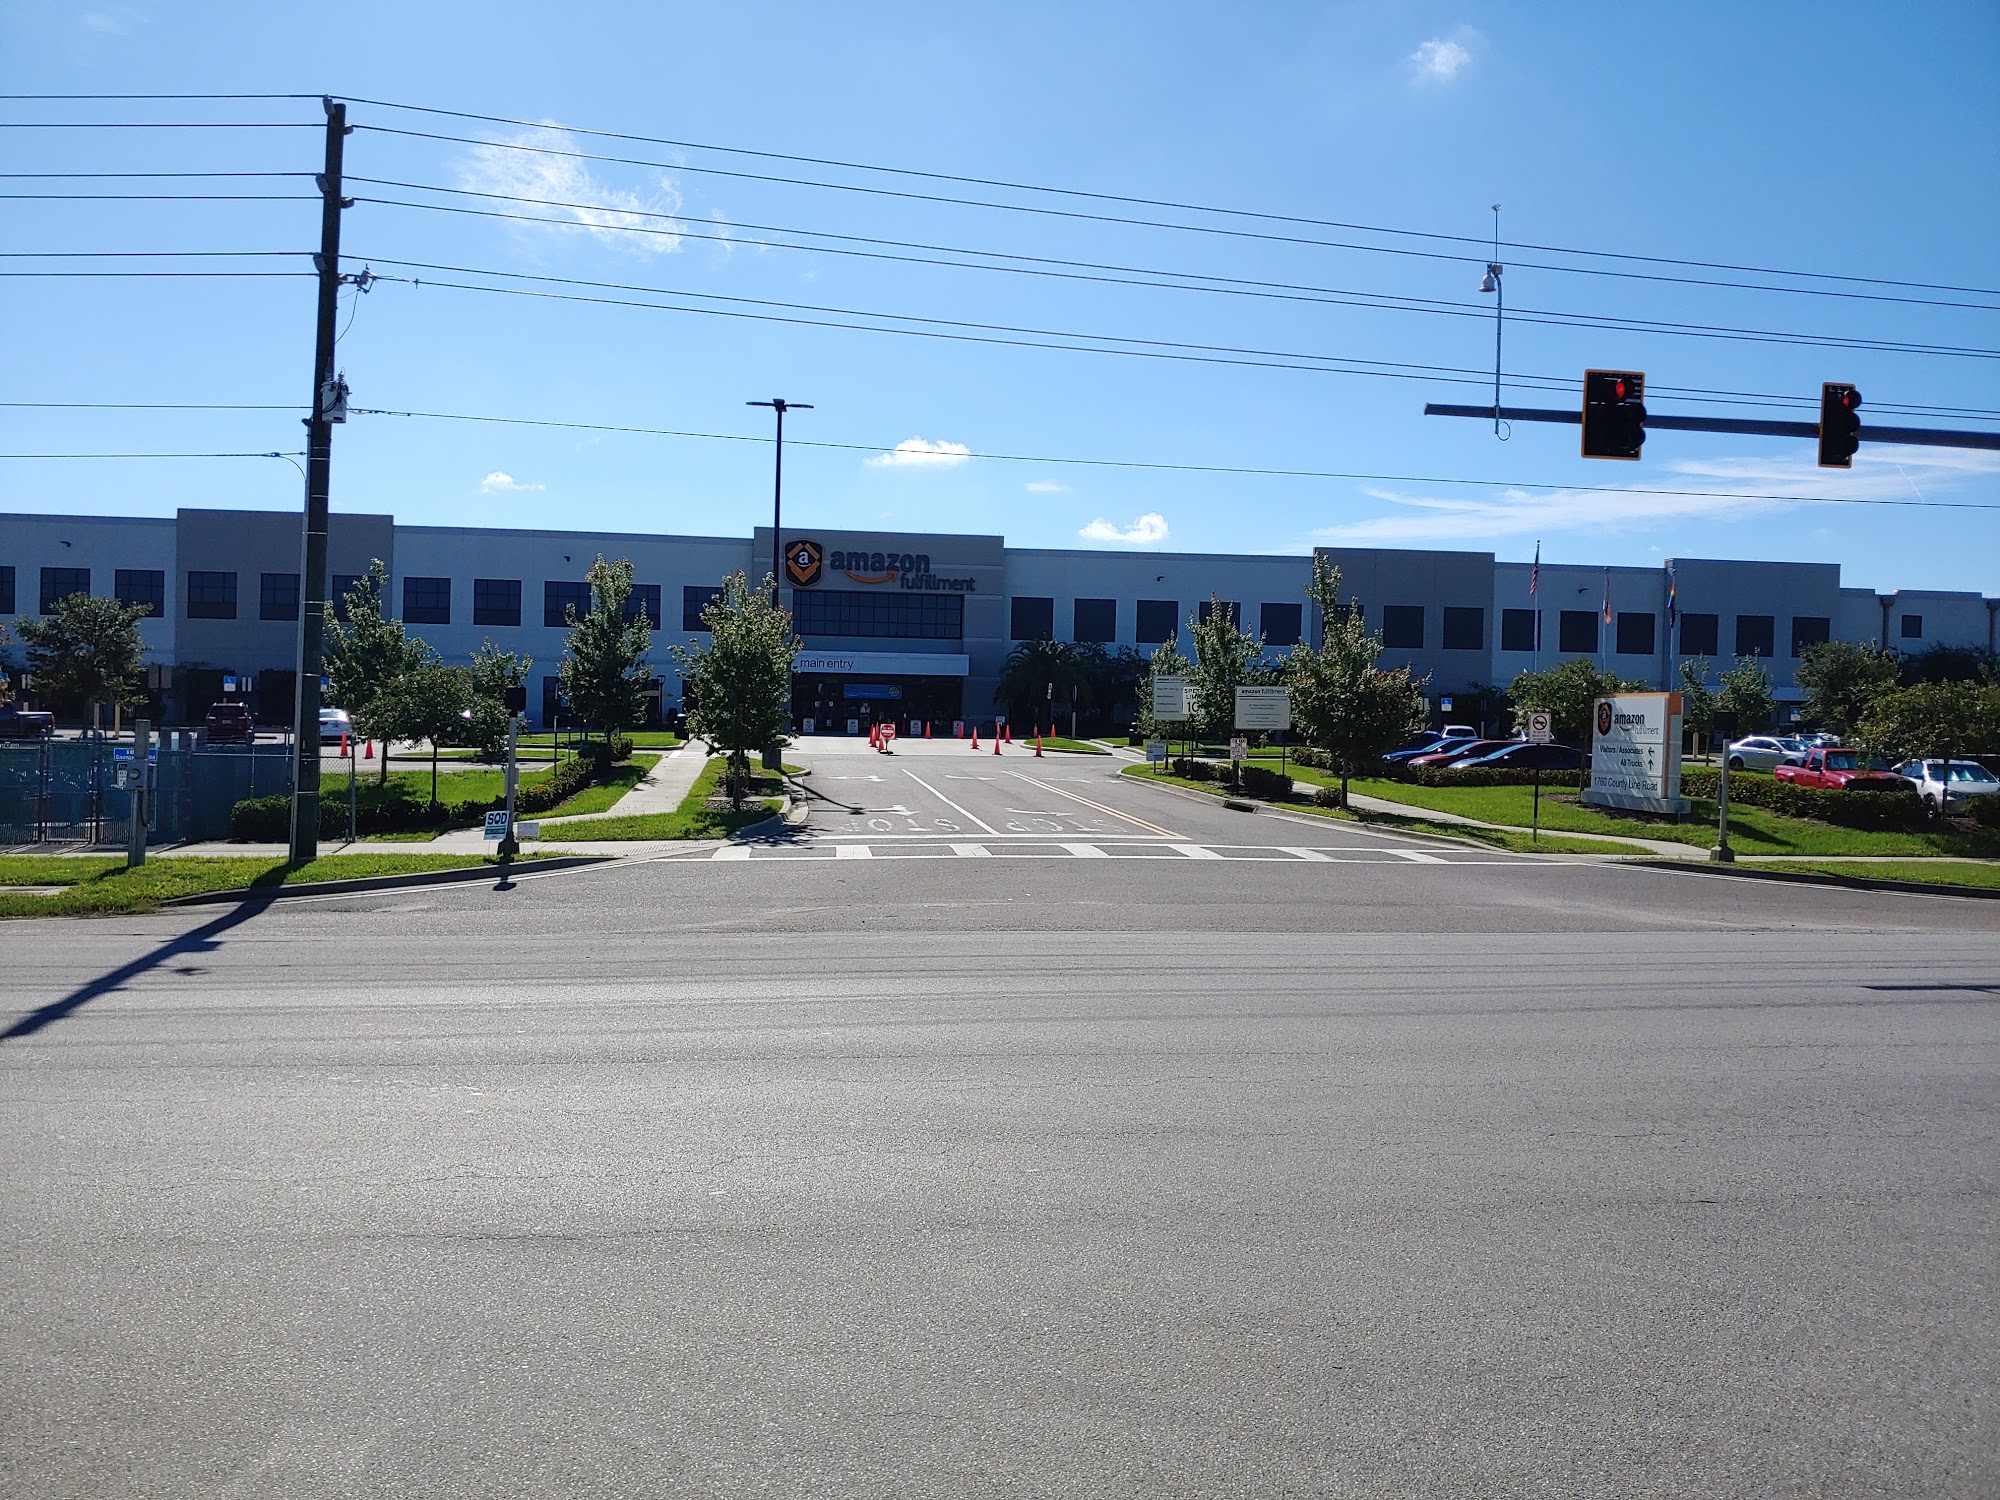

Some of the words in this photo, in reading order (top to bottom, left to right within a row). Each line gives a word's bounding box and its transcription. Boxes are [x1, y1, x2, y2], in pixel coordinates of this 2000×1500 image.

[829, 550, 930, 573] amazon
[900, 573, 976, 592] fulfillment
[800, 658, 825, 668] main
[827, 659, 854, 671] entry
[1187, 701, 1200, 712] 10
[1614, 713, 1645, 725] amazon
[1632, 724, 1659, 735] fulfillment
[1600, 745, 1616, 754] Visitors
[1619, 746, 1644, 755] Associates
[1628, 759, 1643, 768] Trucks
[1608, 777, 1628, 790] County
[1628, 779, 1641, 790] Line
[1642, 780, 1658, 791] Road
[487, 812, 507, 825] SOD
